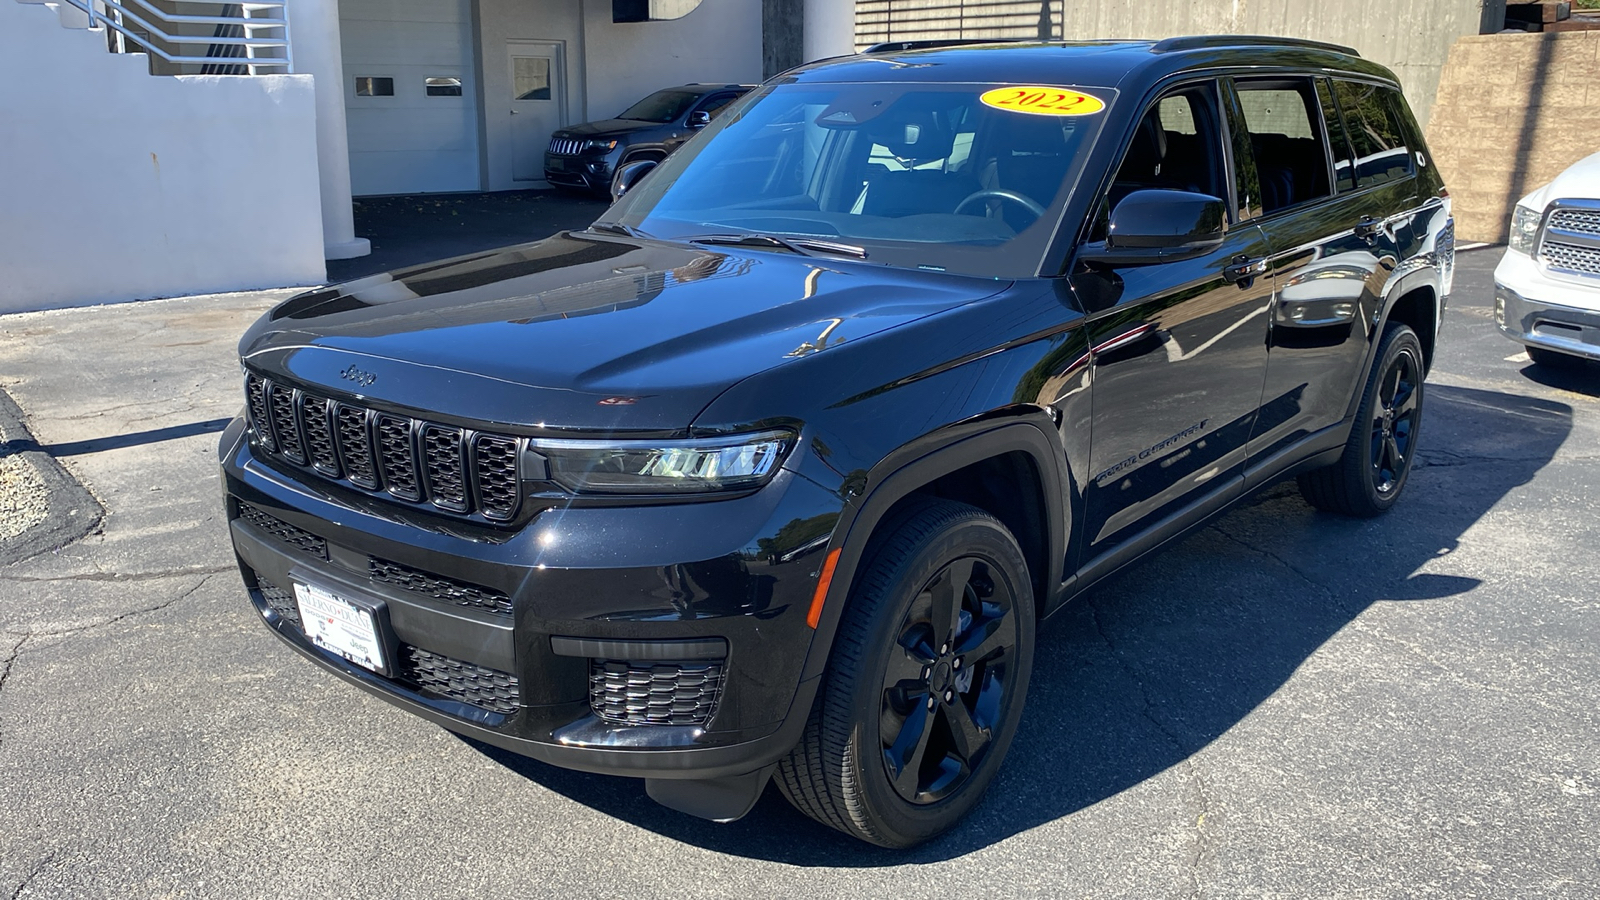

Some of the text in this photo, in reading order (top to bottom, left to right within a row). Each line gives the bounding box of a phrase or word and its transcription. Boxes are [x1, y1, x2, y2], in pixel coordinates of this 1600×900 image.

[996, 91, 1085, 110] 2022
[340, 364, 377, 387] Jeep
[297, 591, 337, 616] SALERNO
[341, 610, 373, 631] DUANE
[349, 638, 369, 655] Jeep
